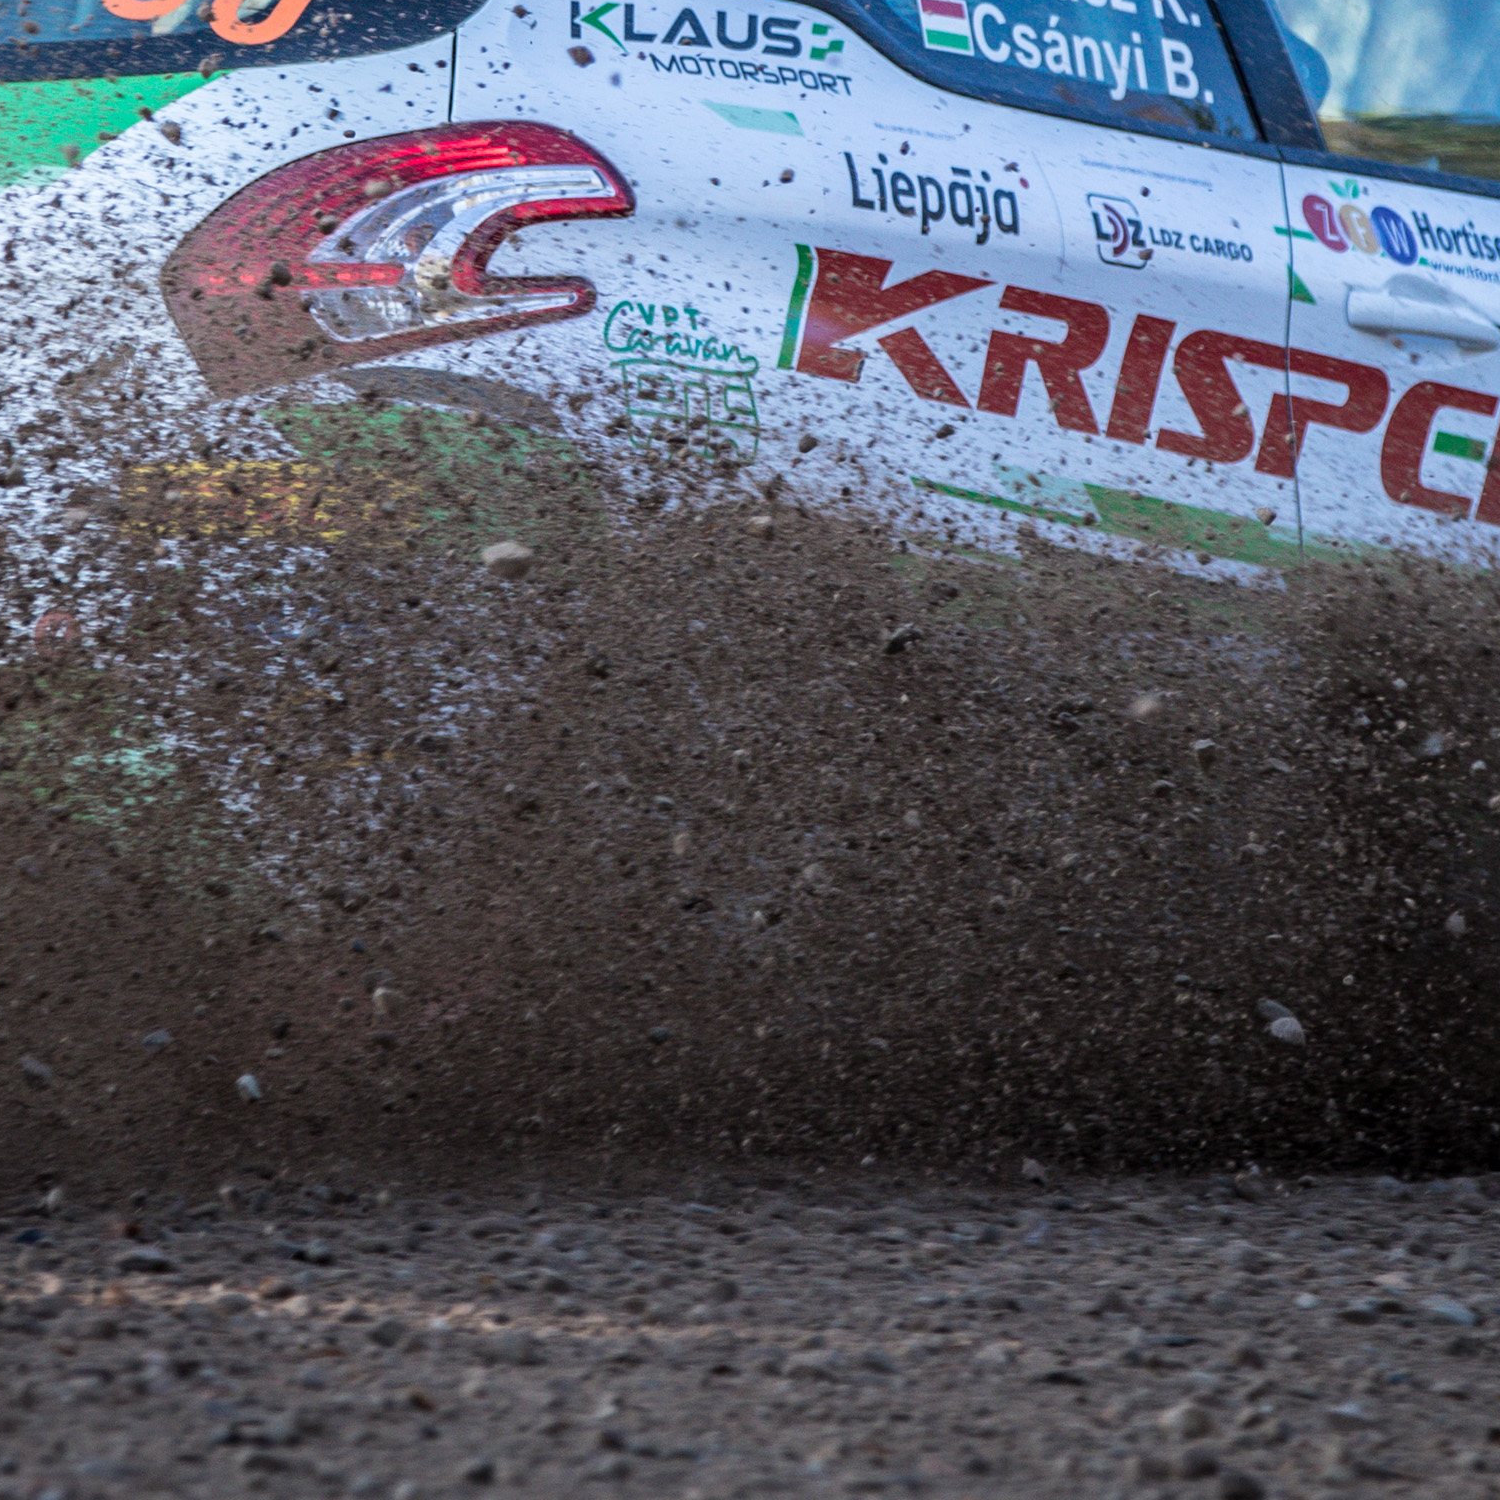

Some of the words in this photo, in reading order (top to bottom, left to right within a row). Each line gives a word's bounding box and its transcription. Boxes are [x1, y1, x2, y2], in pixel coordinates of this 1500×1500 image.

[650, 53, 853, 96] MOTORSPORT
[972, 2, 1148, 100] Csányi
[1161, 38, 1214, 104] B.
[843, 151, 1021, 245] Liepāja
[1148, 227, 1185, 250] LDZ
[1190, 233, 1253, 263] CARGO
